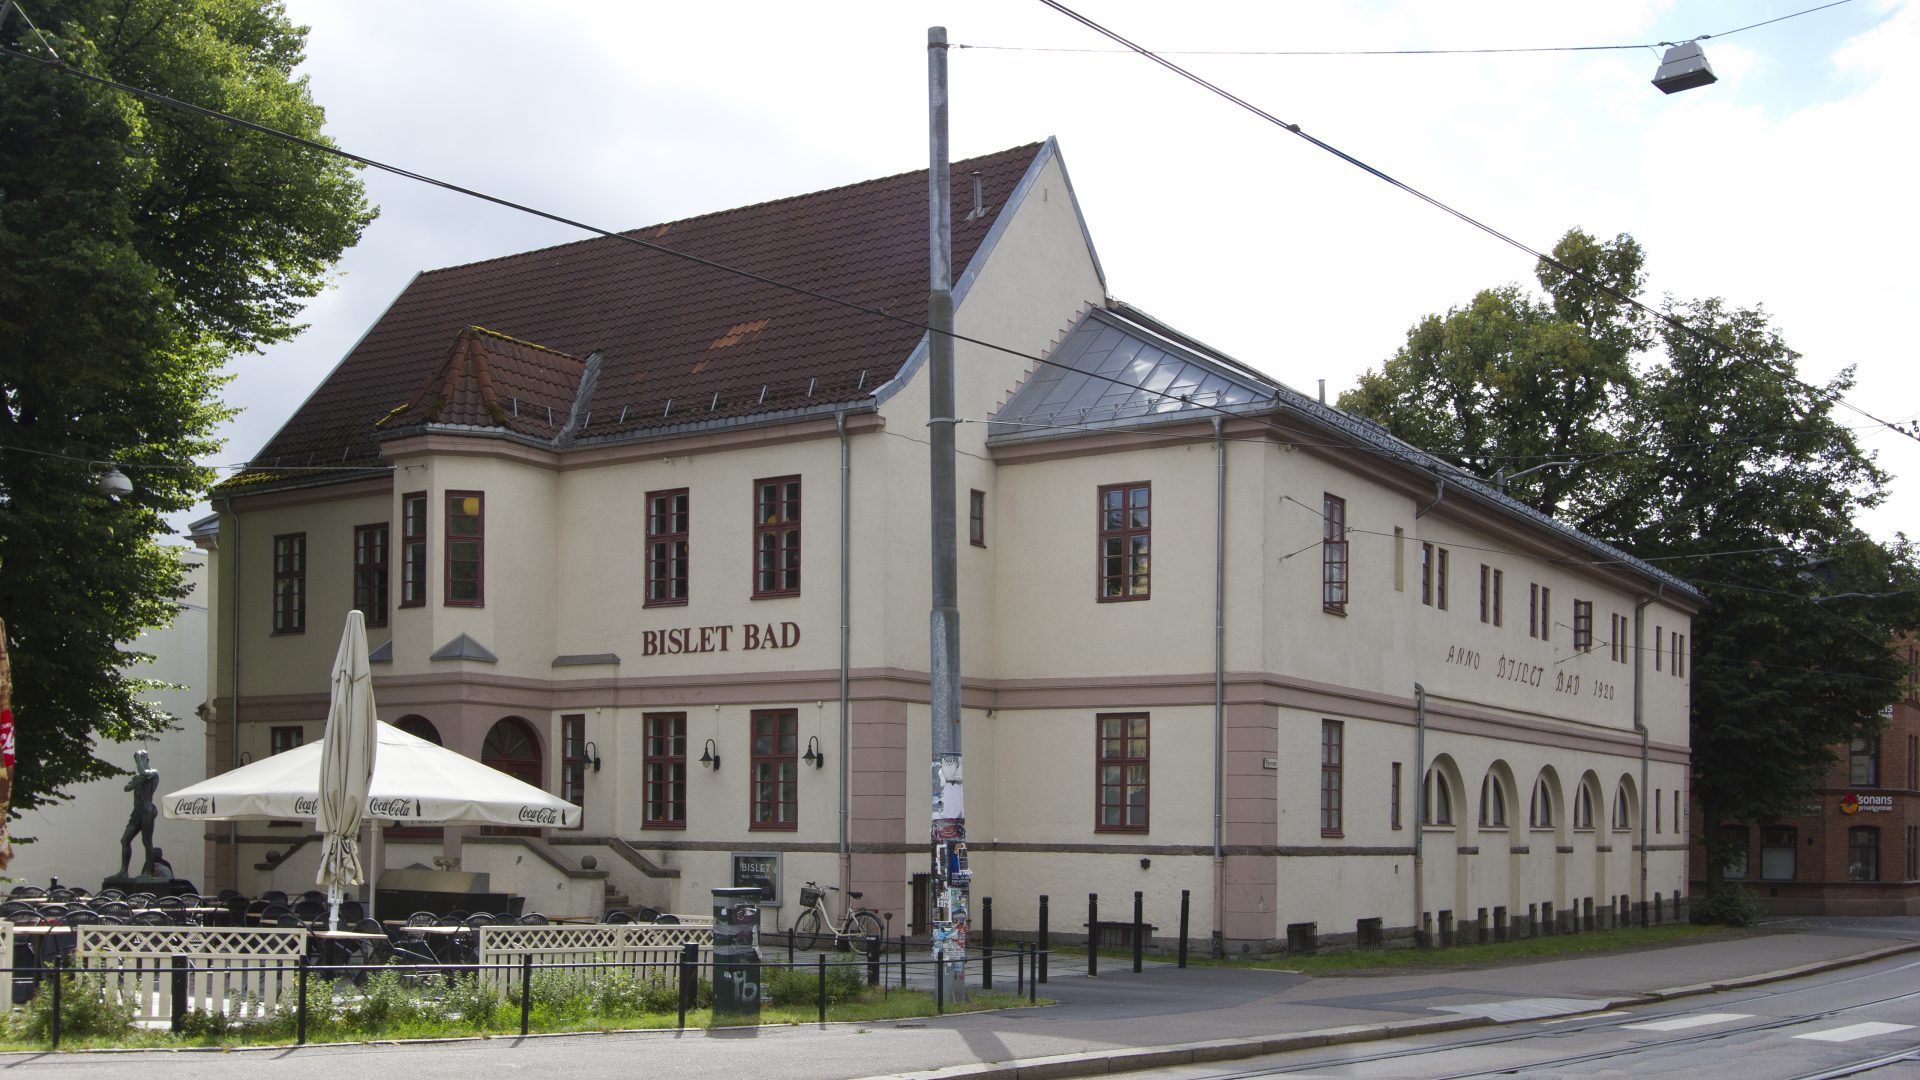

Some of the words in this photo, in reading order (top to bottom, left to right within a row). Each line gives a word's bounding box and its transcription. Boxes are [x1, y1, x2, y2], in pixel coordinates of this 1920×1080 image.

[641, 624, 733, 656] BISLET
[743, 621, 801, 651] BAD
[1446, 645, 1481, 671] ANNO
[1555, 669, 1580, 696] BAD
[1593, 679, 1614, 700] 1920
[294, 796, 317, 815] Coca-C
[1858, 795, 1893, 805] sonans
[741, 863, 771, 872] BISLET
